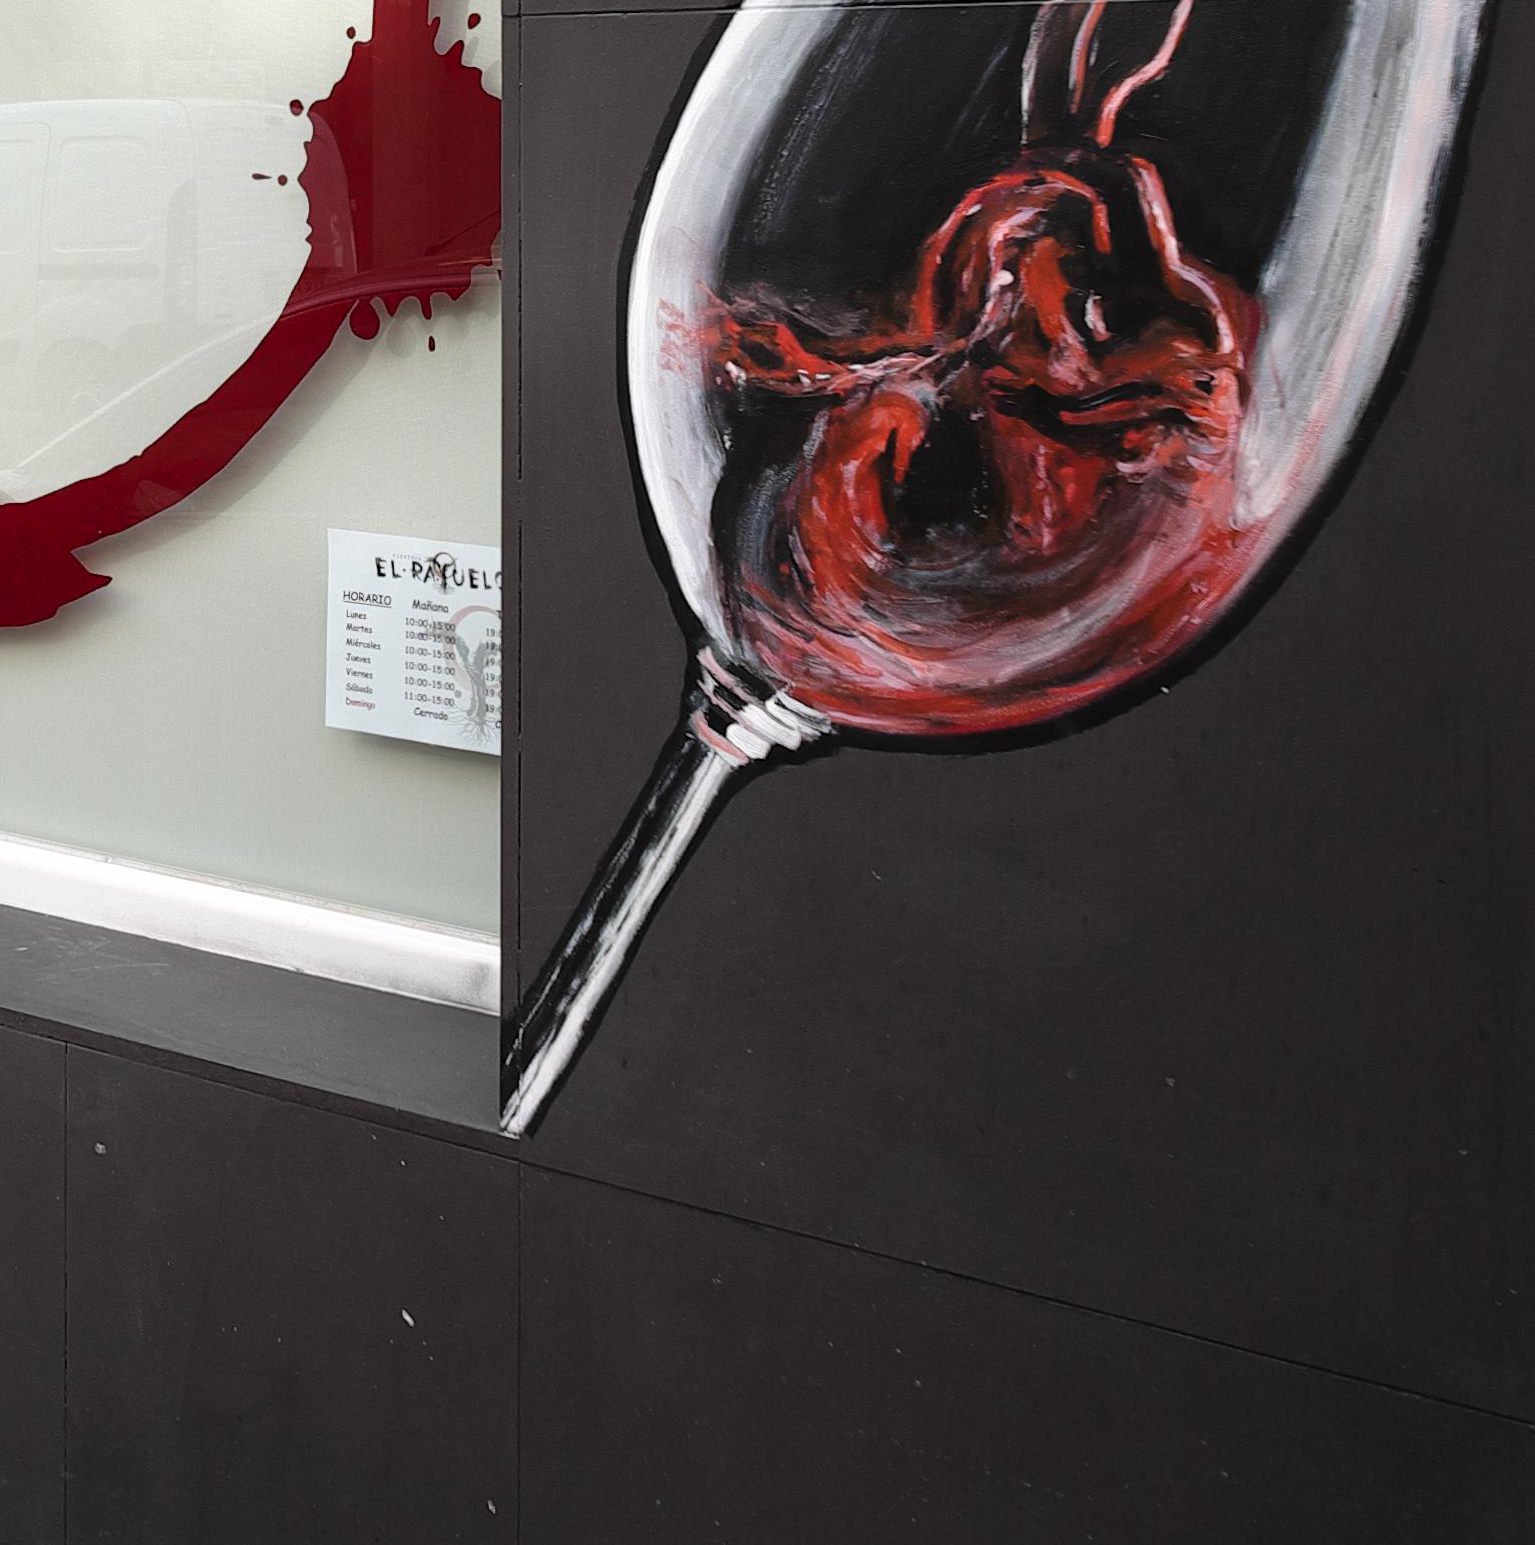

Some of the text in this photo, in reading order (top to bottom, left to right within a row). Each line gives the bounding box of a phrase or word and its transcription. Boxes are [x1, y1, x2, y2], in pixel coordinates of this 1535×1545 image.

[375, 557, 402, 579] EL
[343, 590, 392, 606] HORARIO
[412, 599, 449, 614] Mañana
[346, 610, 456, 632] Lunes 10:00-15:00
[346, 623, 373, 634] Martes
[346, 638, 456, 661] Miércoles 10:00-15:00
[405, 661, 456, 676] 10:00-15:00
[346, 668, 455, 691] Viernes 10:00-15:00
[346, 683, 455, 707] Sábado 11:00-15:00
[413, 707, 449, 721] Cerrado
